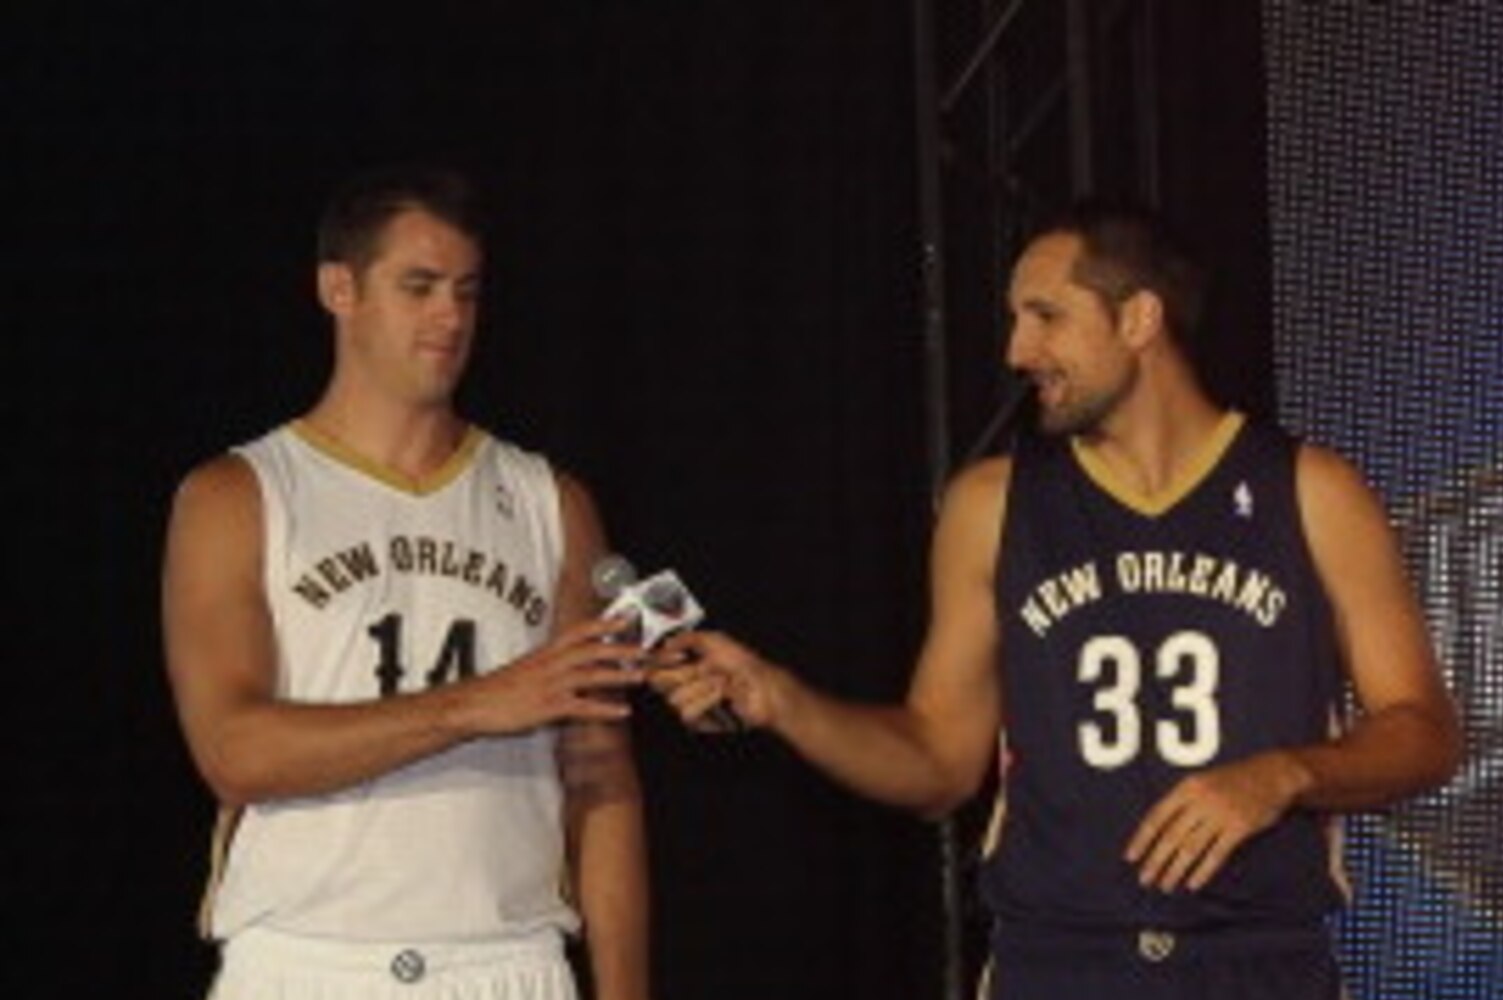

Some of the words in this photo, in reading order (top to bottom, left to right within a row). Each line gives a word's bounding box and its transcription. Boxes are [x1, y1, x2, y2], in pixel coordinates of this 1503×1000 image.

[293, 540, 381, 611] NEW
[388, 535, 549, 628] ORLEANS
[1020, 560, 1101, 639] NEW
[1116, 551, 1287, 628] ORLEANS
[367, 612, 478, 699] 14
[1077, 628, 1221, 770] 33
